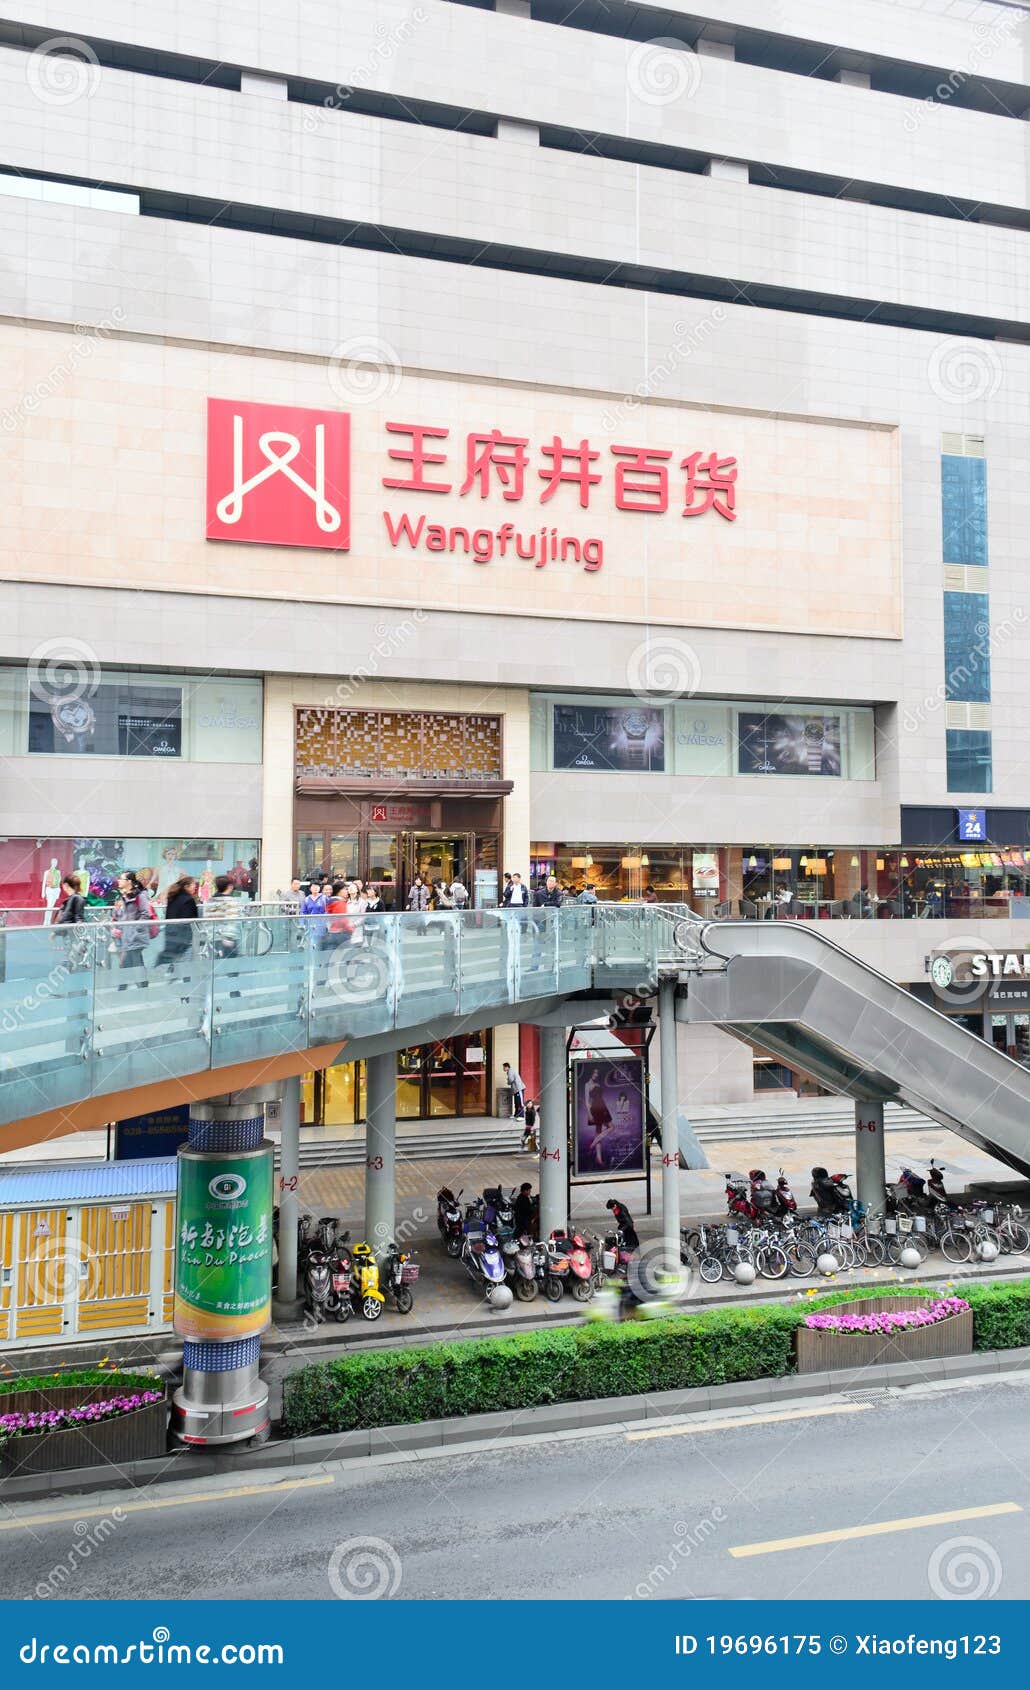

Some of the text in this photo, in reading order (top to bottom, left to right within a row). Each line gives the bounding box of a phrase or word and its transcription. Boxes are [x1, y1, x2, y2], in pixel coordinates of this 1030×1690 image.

[382, 420, 738, 522] 王府井百货
[382, 510, 604, 571] Wangfujing
[965, 822, 981, 834] 24
[541, 1146, 560, 1162] 4-4
[280, 1175, 298, 1192] 4-2
